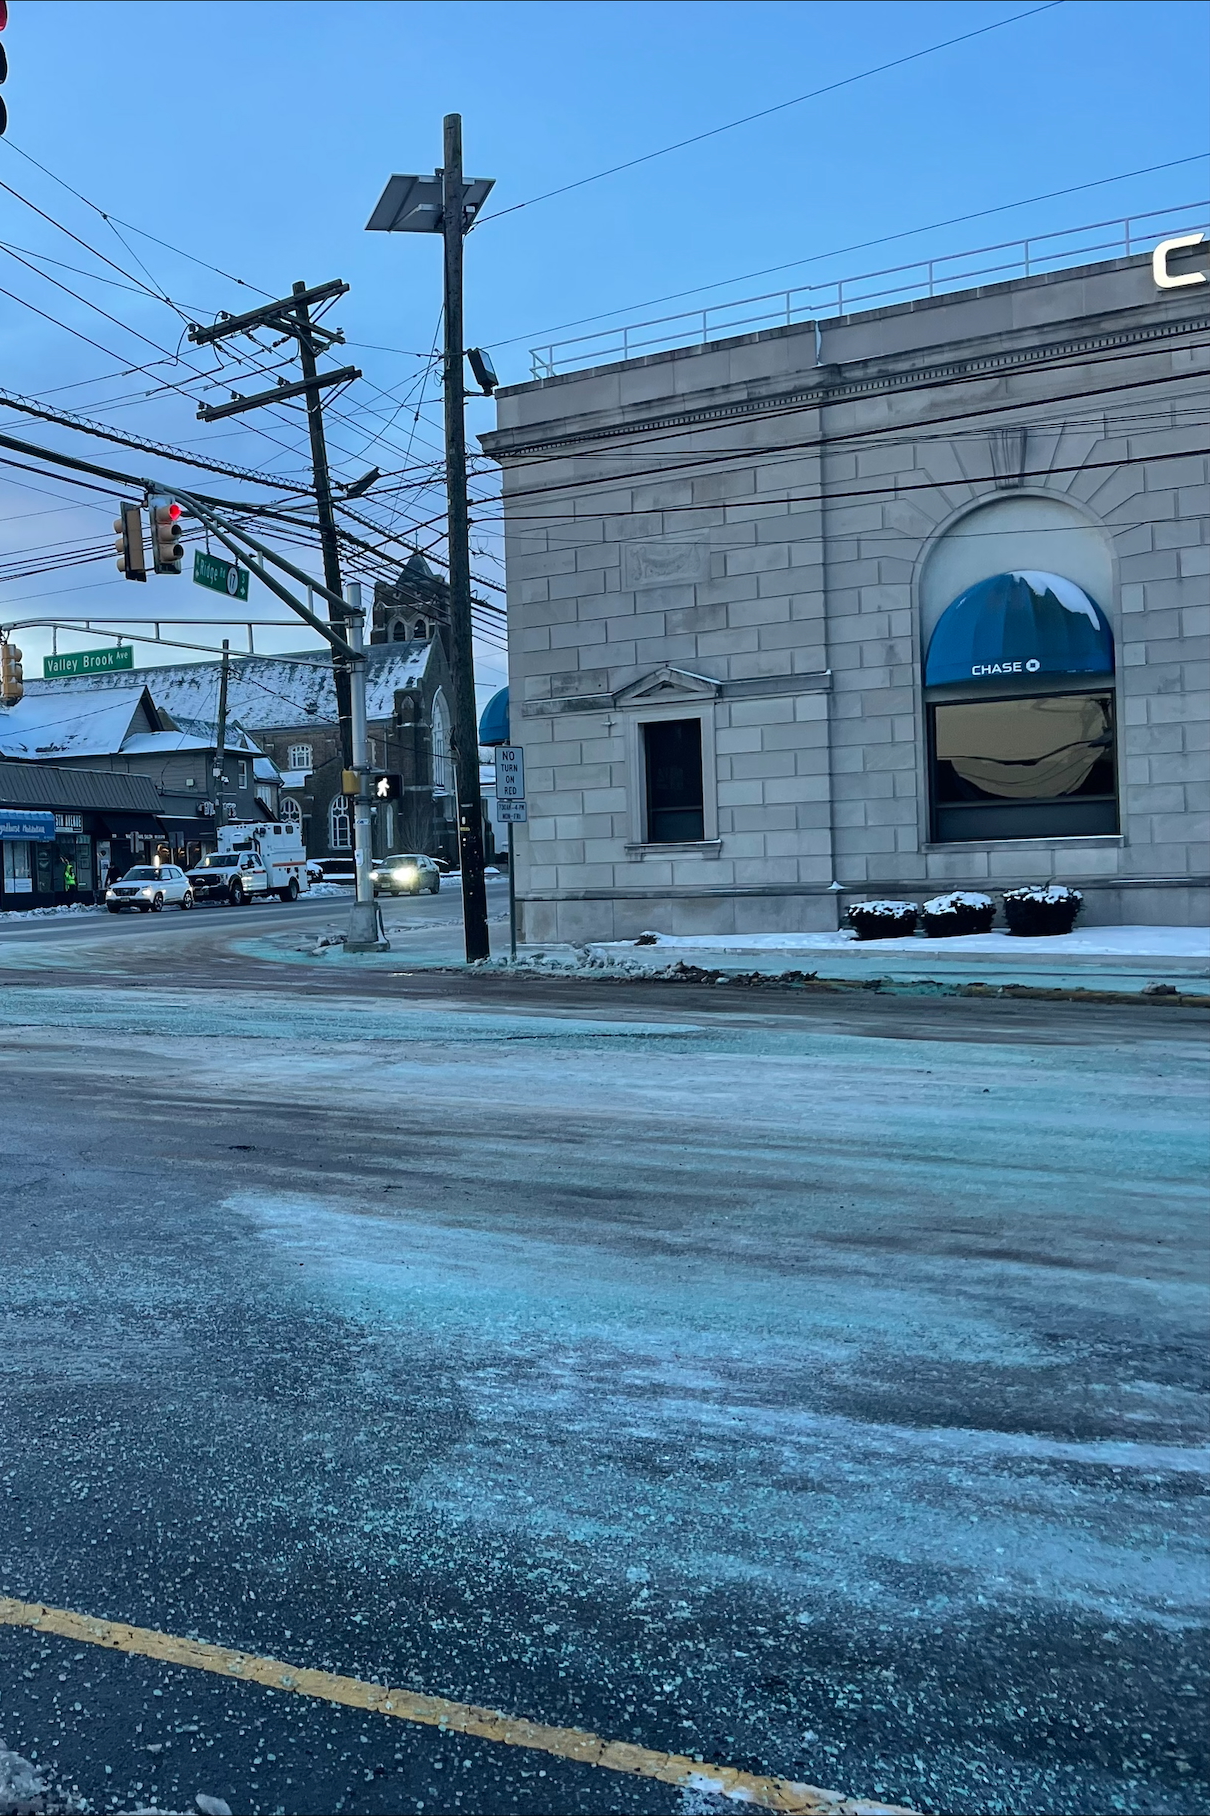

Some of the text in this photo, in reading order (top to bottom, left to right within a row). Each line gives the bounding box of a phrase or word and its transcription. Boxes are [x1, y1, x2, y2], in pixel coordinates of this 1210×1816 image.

[200, 558, 226, 585] Ridge Rd
[47, 651, 129, 672] Valley Brook Ave
[971, 661, 1023, 676] CHASE
[502, 751, 515, 761] NO
[500, 763, 518, 772] TURN
[505, 775, 515, 784] ON
[504, 786, 517, 796] RED
